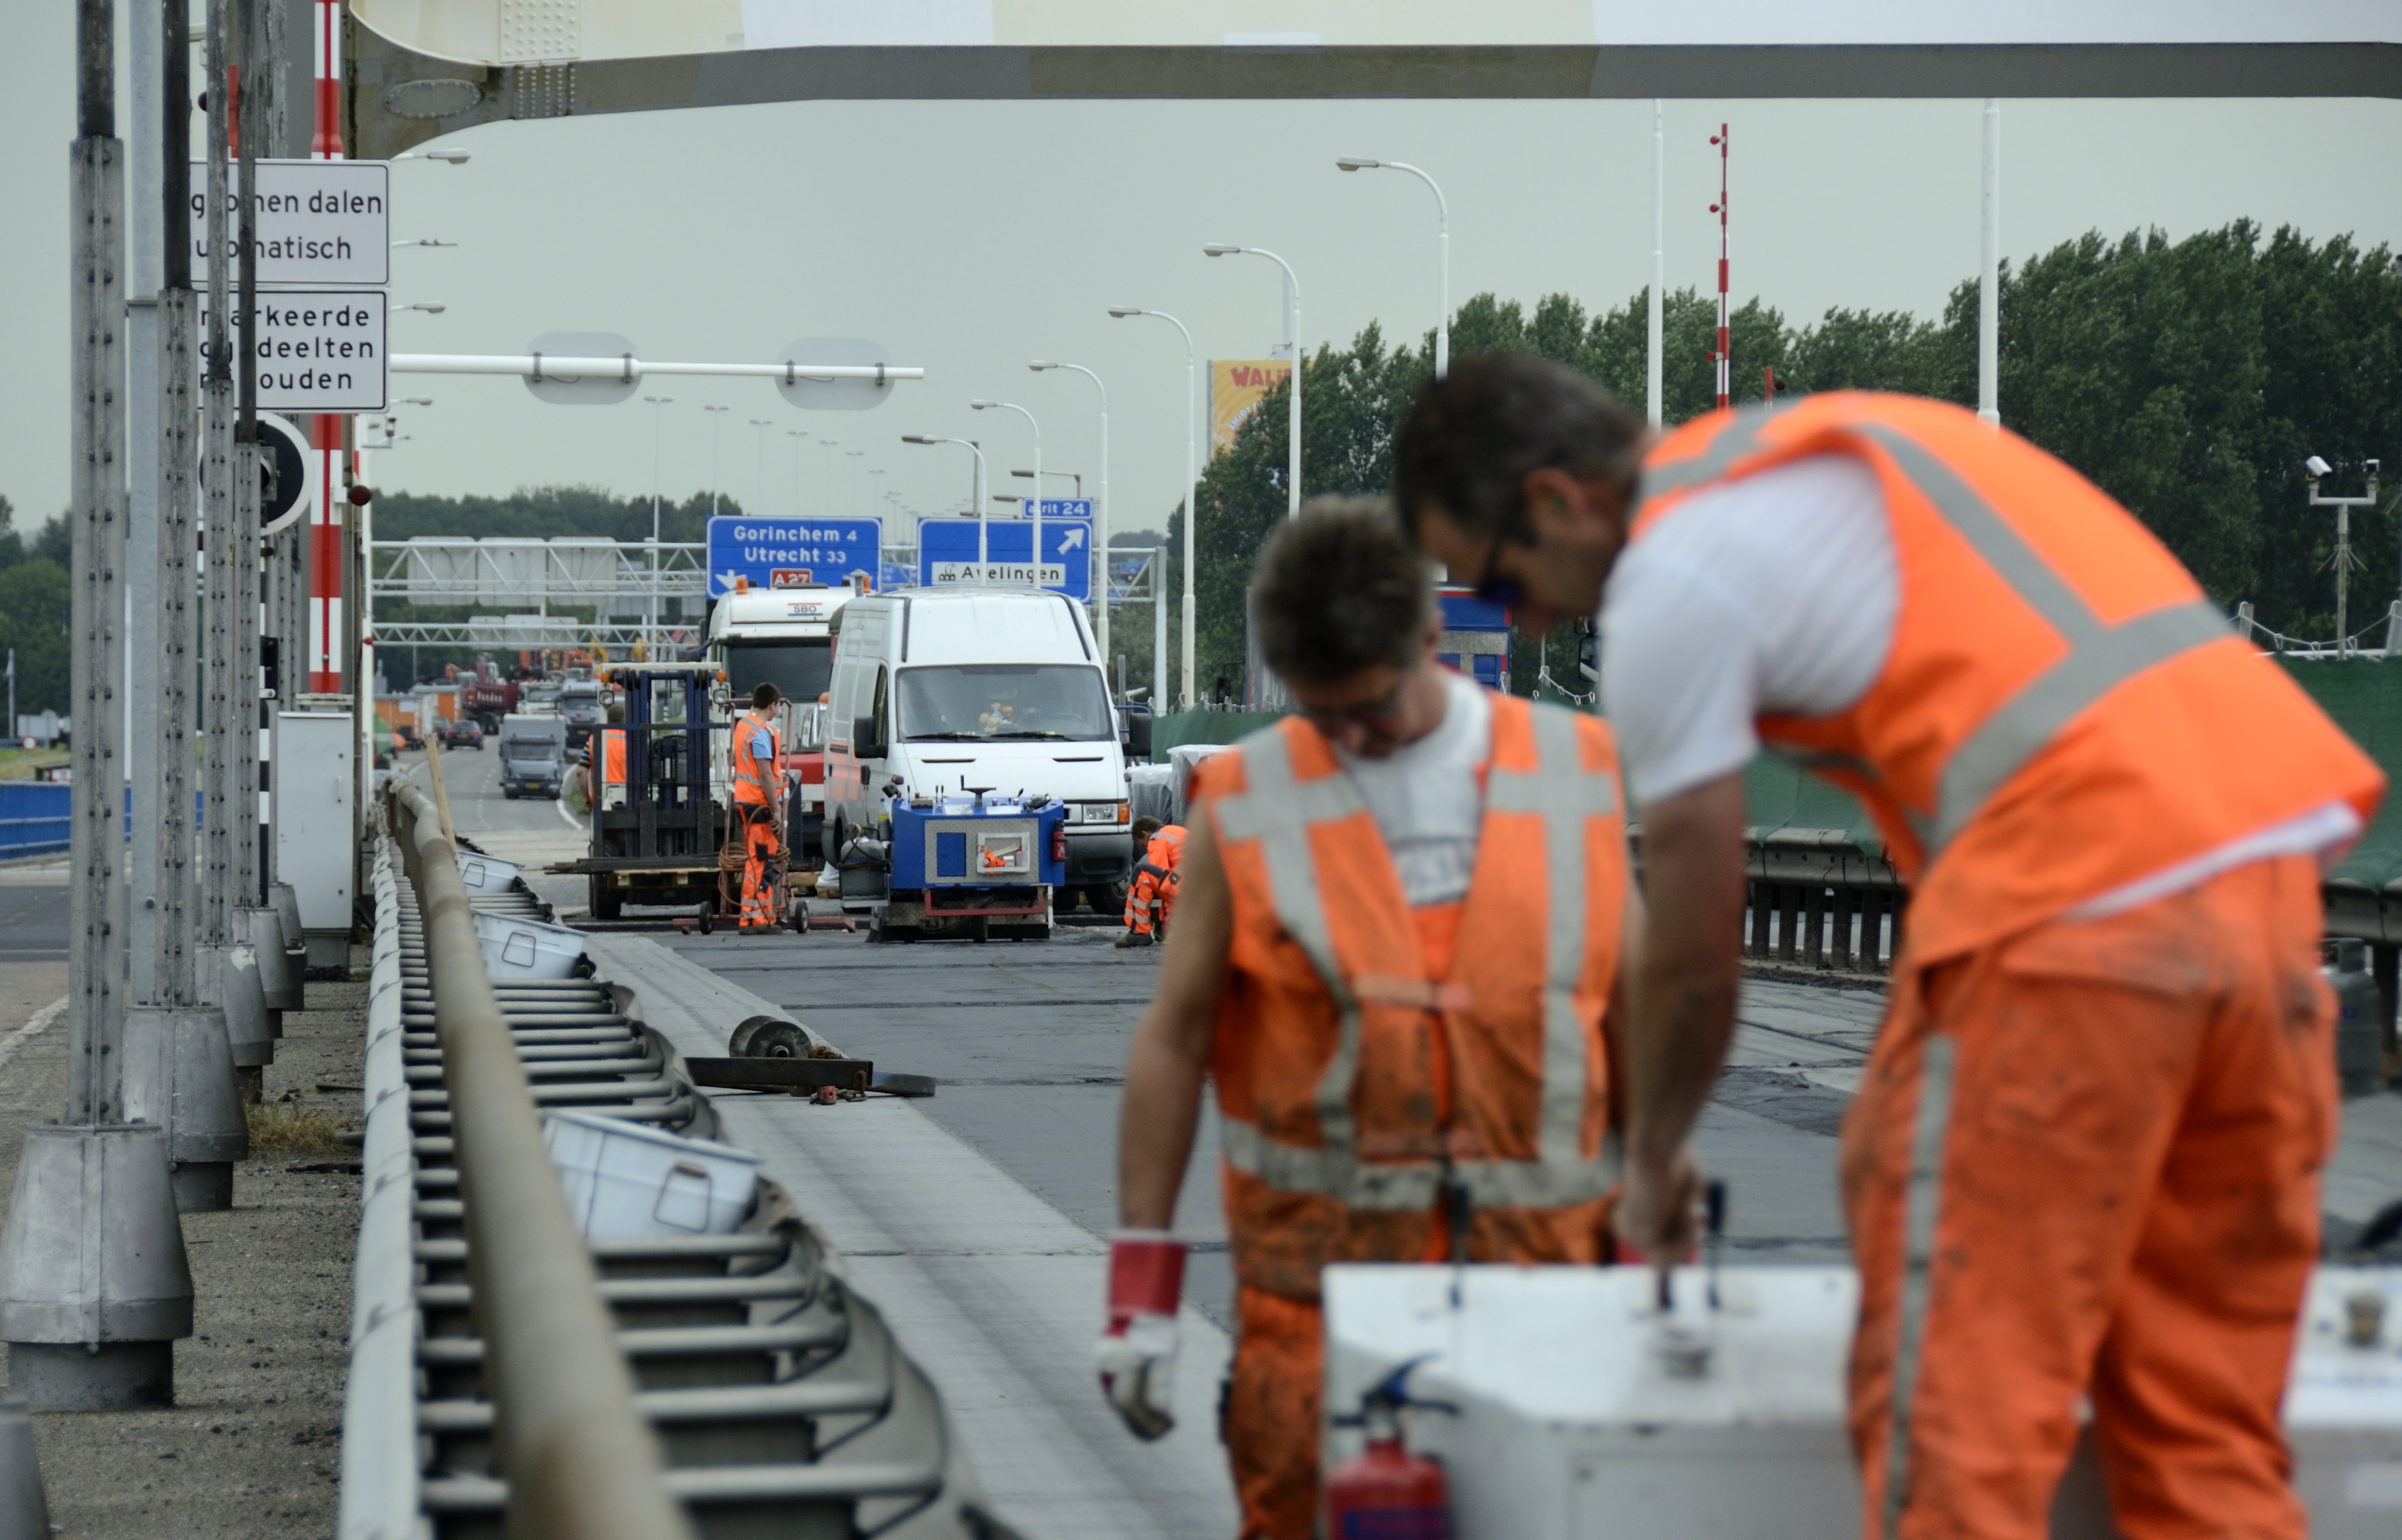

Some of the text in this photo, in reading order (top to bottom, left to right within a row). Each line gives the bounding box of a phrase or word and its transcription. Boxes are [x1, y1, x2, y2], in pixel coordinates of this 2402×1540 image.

[308, 189, 381, 214] dalen
[1028, 502, 1085, 515] arit 24
[734, 525, 858, 542] Gorinchem 4
[744, 546, 846, 564] Utrecht 33
